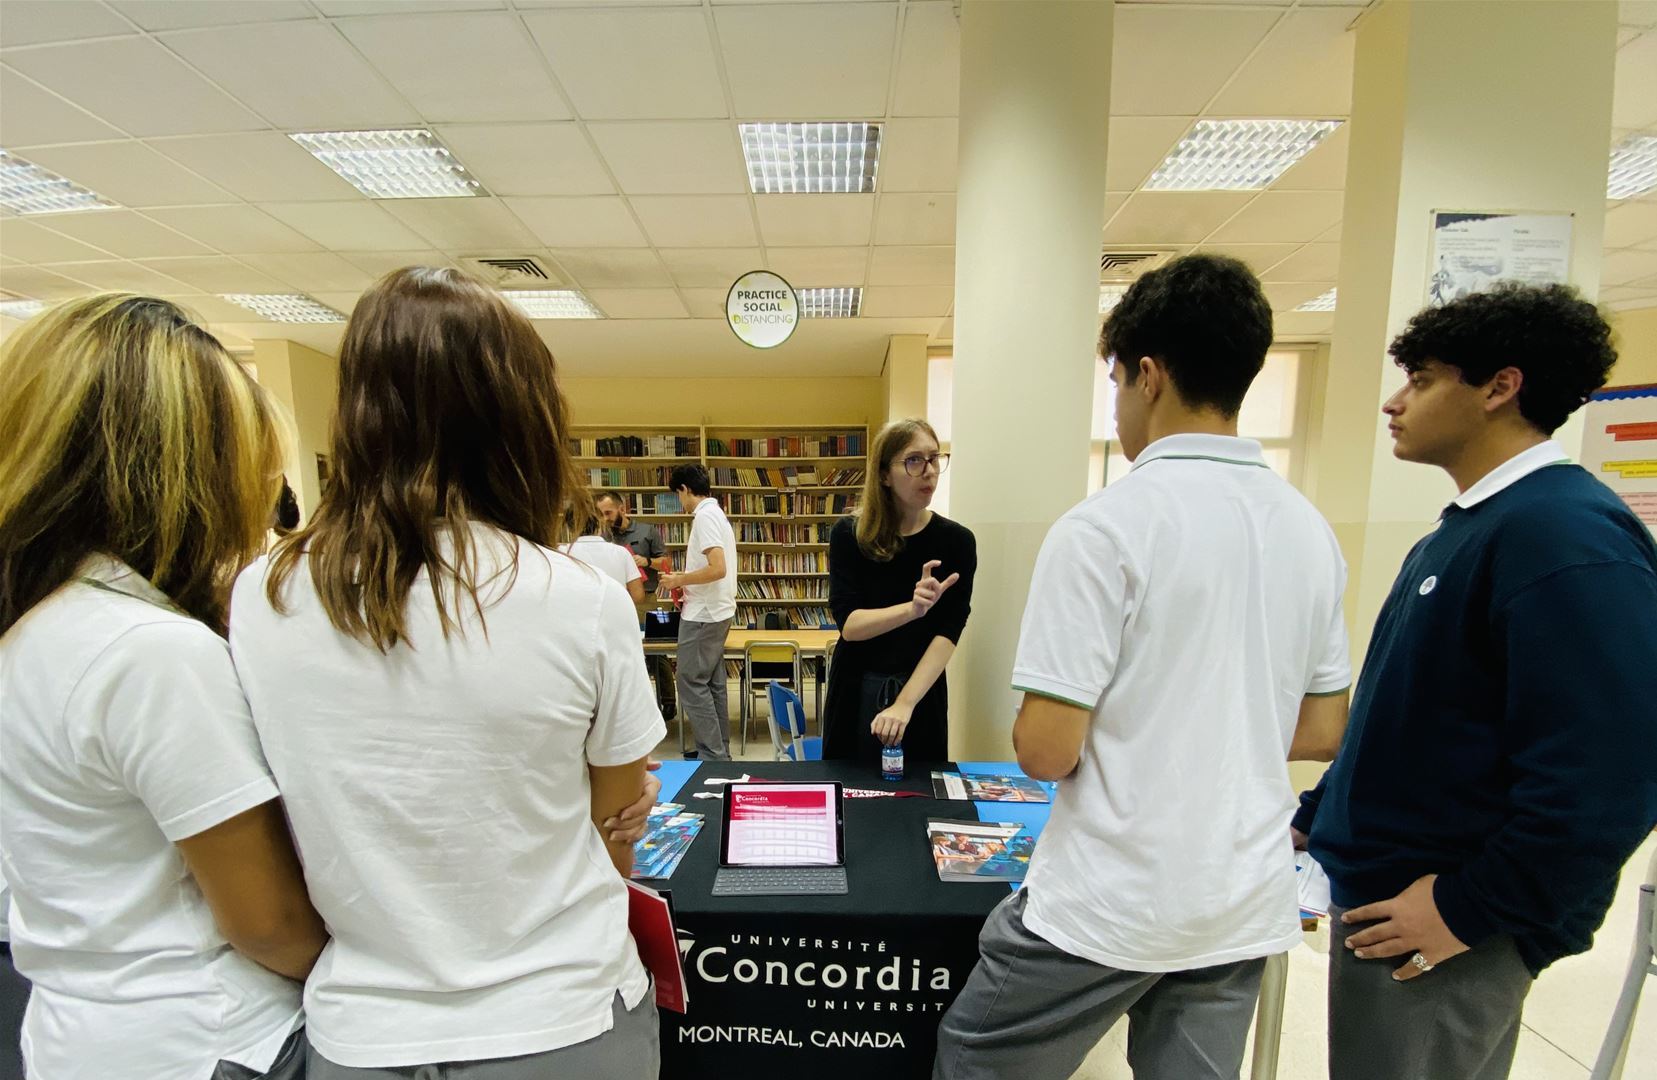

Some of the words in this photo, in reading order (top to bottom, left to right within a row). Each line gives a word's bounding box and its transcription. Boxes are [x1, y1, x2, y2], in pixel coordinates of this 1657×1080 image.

[737, 290, 787, 300] PRACTICE
[743, 302, 783, 312] SOCIAL
[733, 314, 794, 325] DISTANCING
[731, 934, 886, 952] UNIVERSITÉ
[696, 946, 950, 991] Concordia
[807, 999, 945, 1012] UNIVERSIT
[678, 1025, 803, 1048] MONTREAL,
[810, 1030, 906, 1048] CANADA
